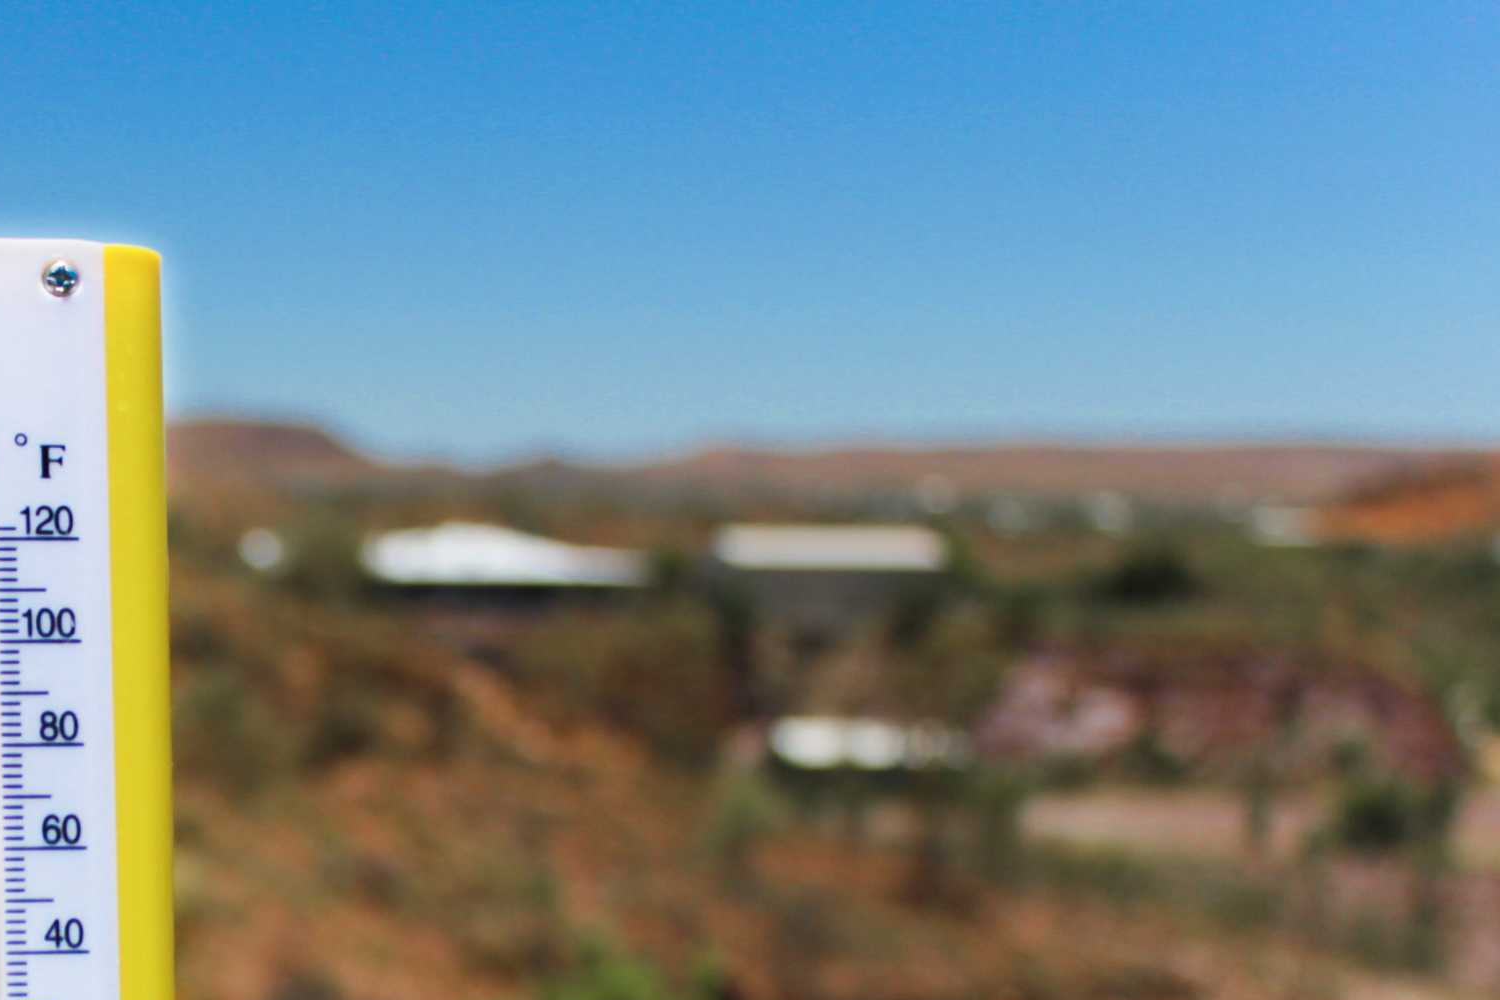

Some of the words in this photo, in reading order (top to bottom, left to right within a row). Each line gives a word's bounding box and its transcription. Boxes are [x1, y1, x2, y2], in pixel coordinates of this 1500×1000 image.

[20, 506, 74, 535] 120
[22, 608, 76, 638] 100
[39, 711, 79, 741] 80
[41, 815, 81, 845] 60
[44, 918, 84, 948] 40
